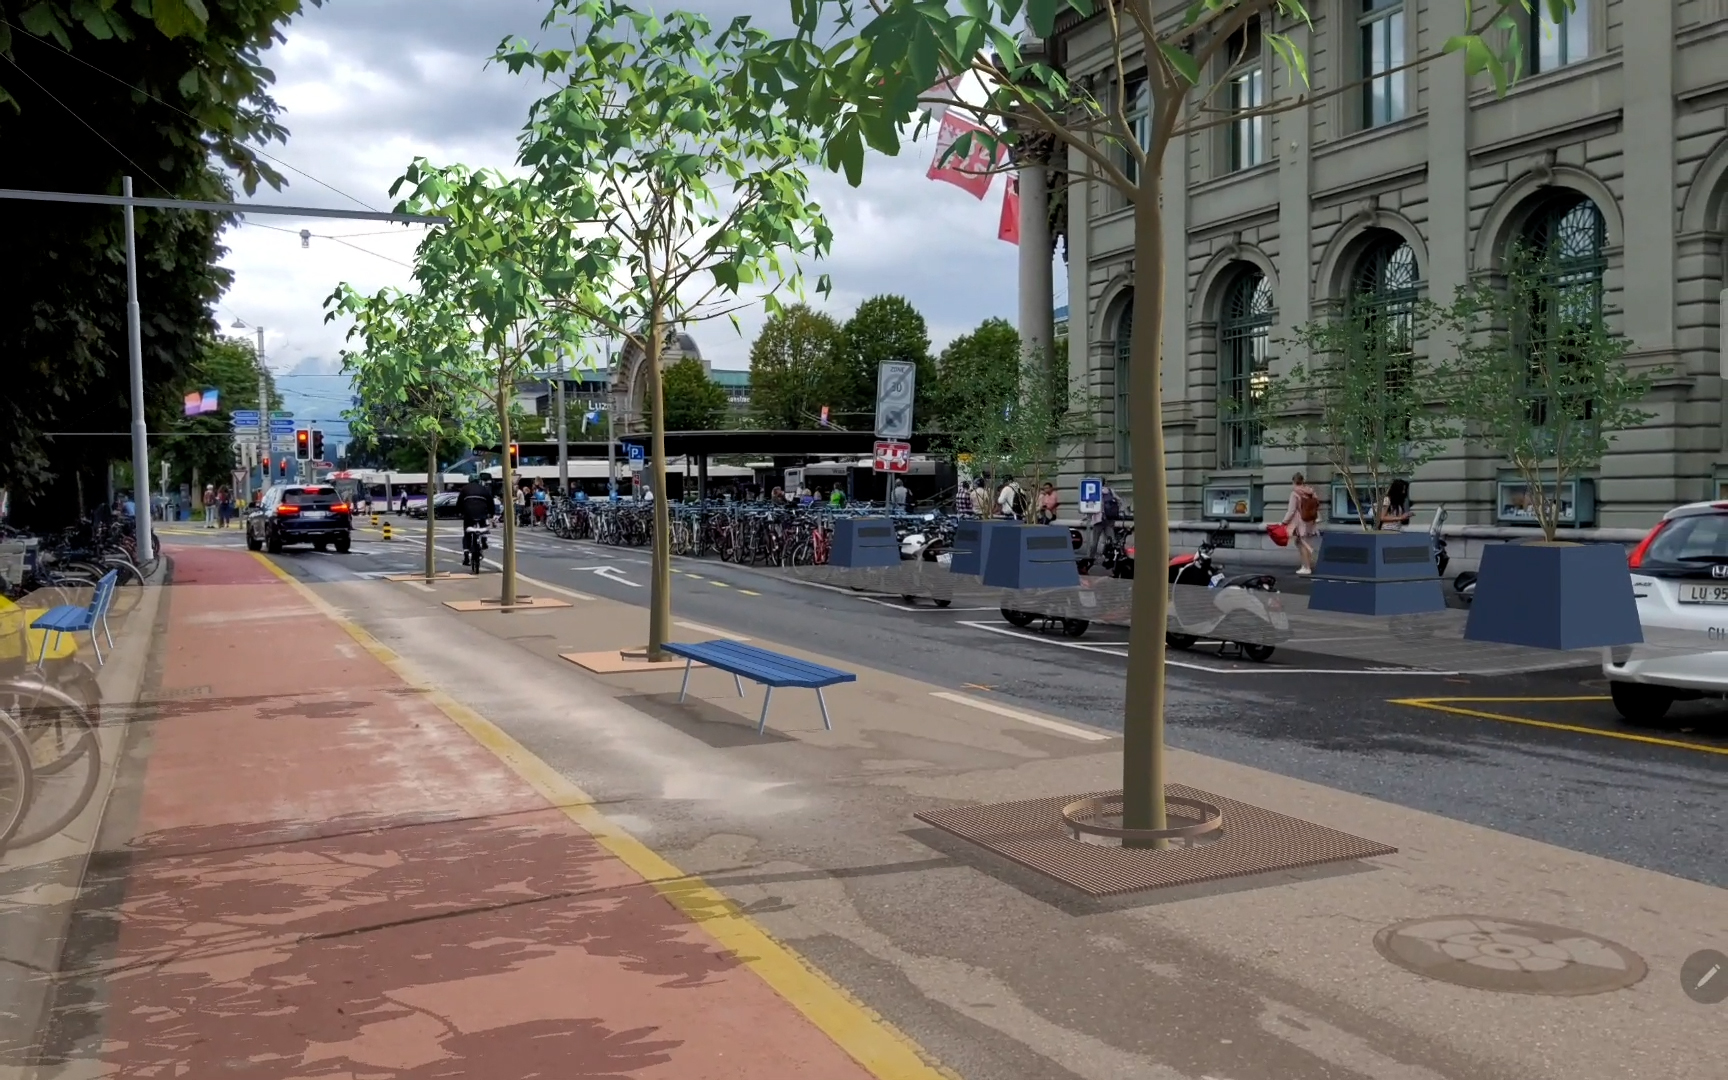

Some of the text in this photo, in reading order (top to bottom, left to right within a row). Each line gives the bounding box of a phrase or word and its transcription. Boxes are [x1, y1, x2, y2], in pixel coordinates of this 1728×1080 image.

[890, 382, 902, 392] 30
[631, 447, 639, 459] P
[1085, 483, 1096, 500] P
[1691, 586, 1707, 600] LU
